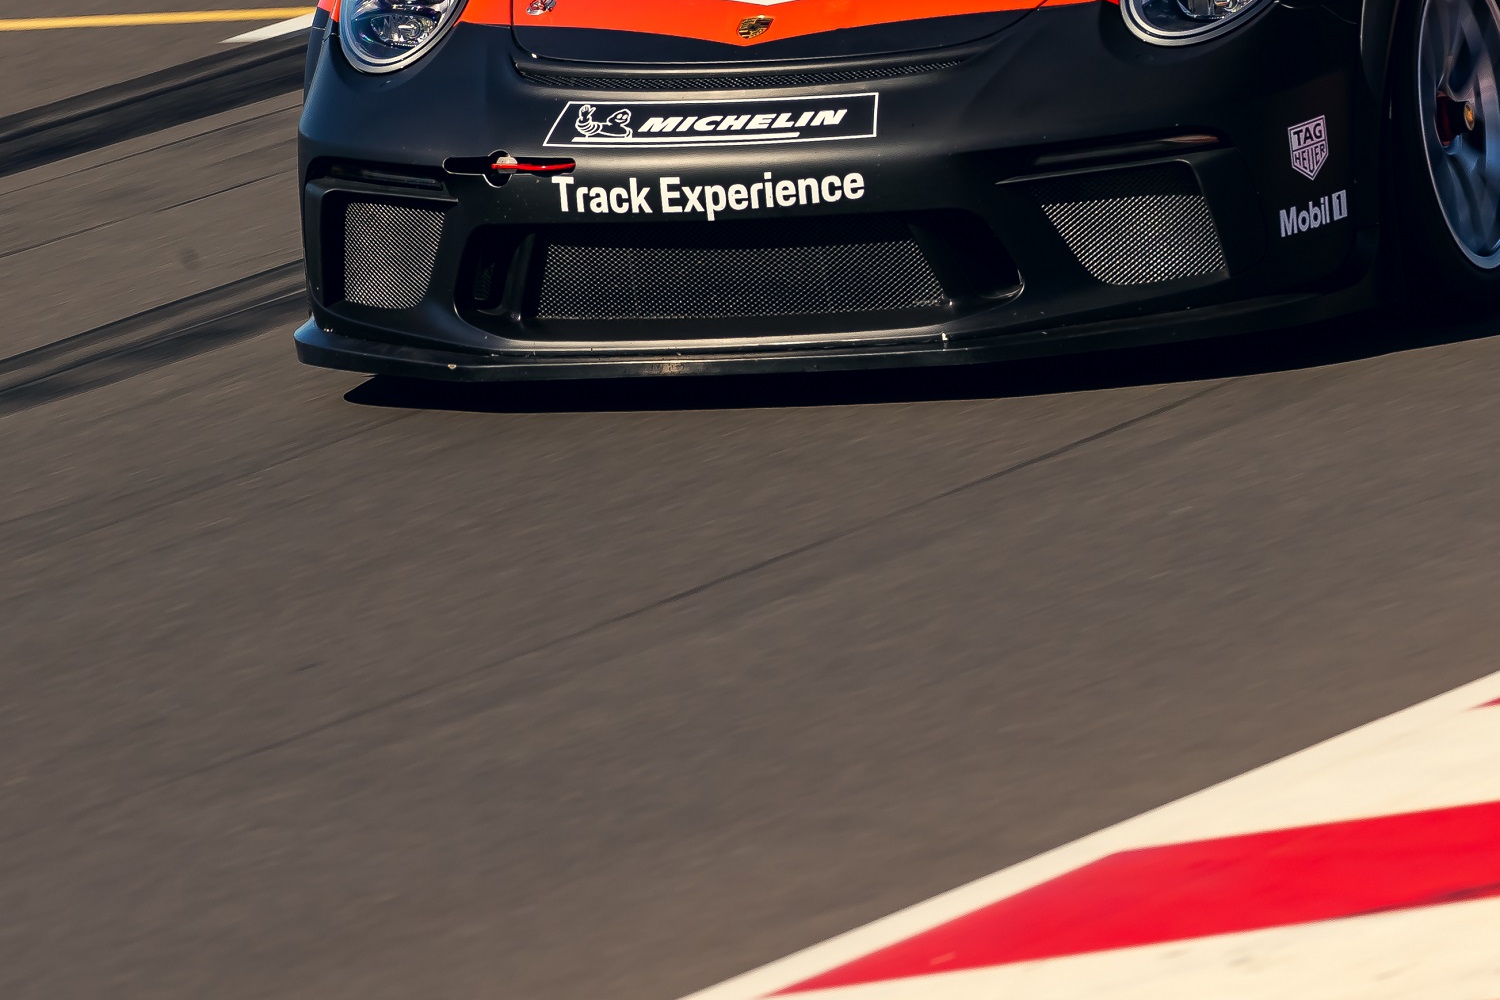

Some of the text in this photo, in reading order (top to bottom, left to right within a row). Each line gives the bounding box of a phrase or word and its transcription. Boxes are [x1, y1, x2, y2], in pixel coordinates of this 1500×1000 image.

[637, 108, 848, 133] MICHELIN
[1292, 122, 1323, 146] TAG
[1294, 143, 1326, 174] HEUER
[551, 171, 865, 221] Track Experience
[1279, 195, 1331, 237] Mobil
